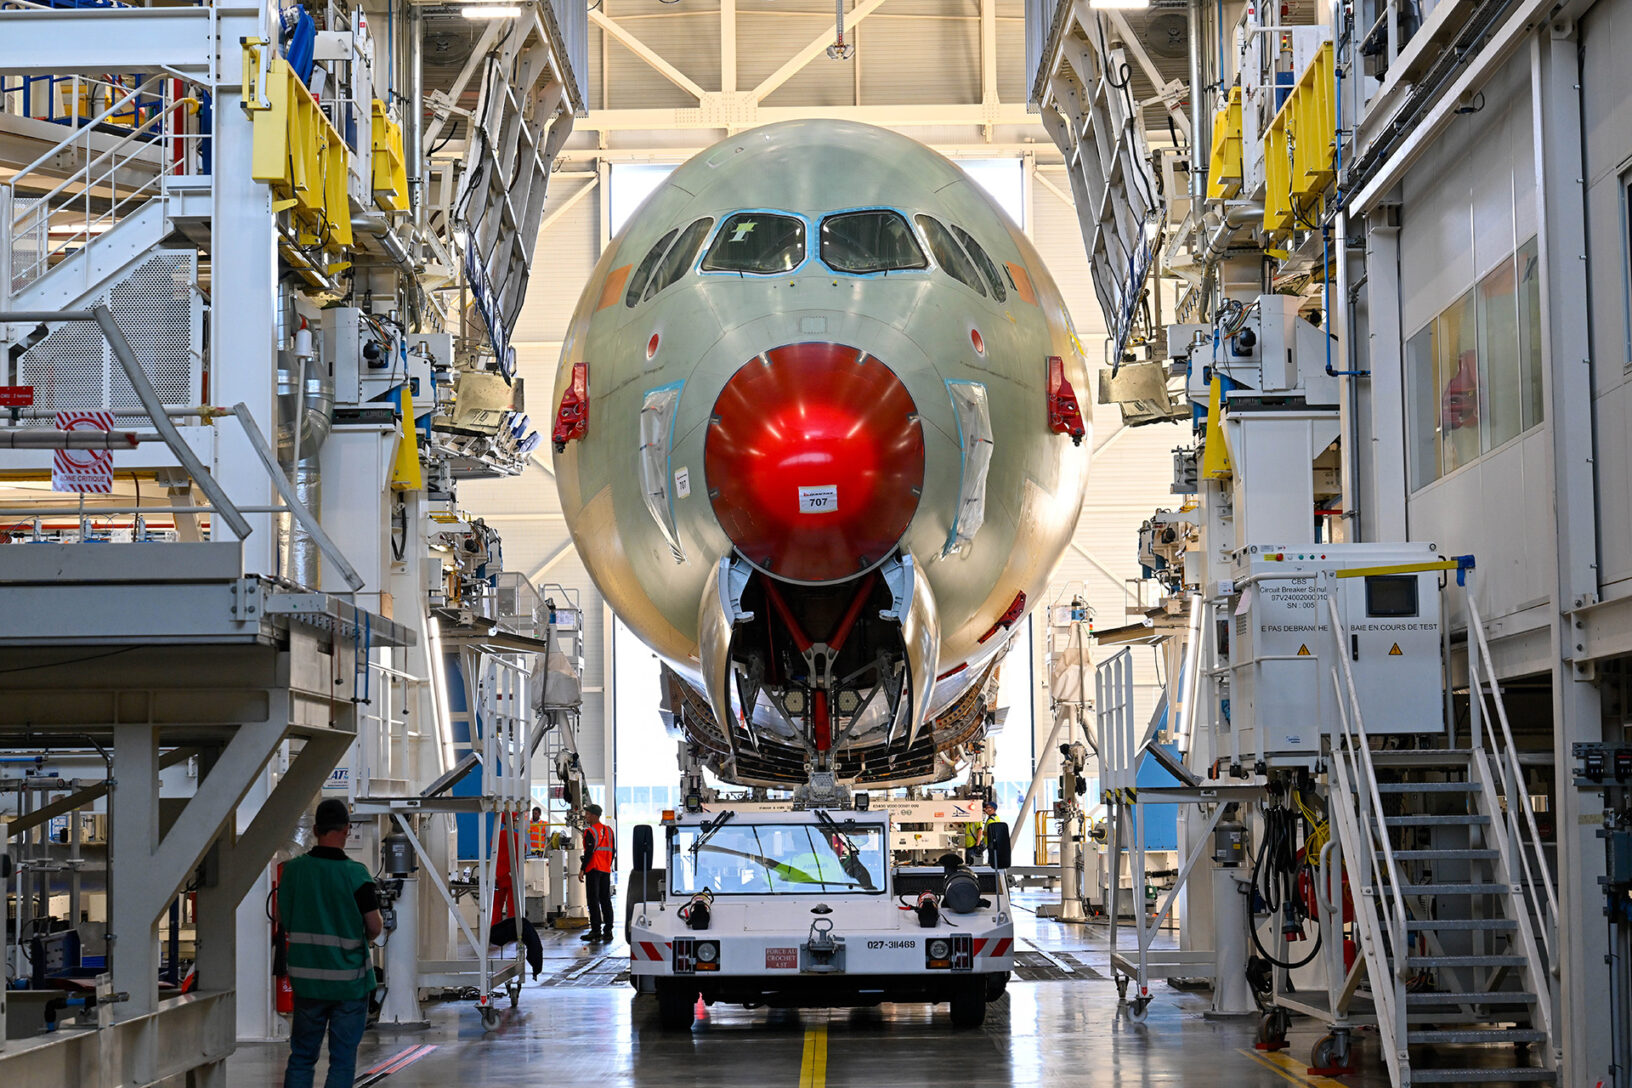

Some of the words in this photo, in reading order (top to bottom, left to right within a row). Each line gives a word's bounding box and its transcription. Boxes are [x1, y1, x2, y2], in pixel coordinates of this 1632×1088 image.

[809, 498, 828, 507] 707
[1259, 586, 1280, 594] Circuit
[1350, 624, 1367, 632] BAIE
[1407, 623, 1418, 631] DE
[1420, 623, 1438, 631] TEST
[867, 940, 916, 950] 027-311469
